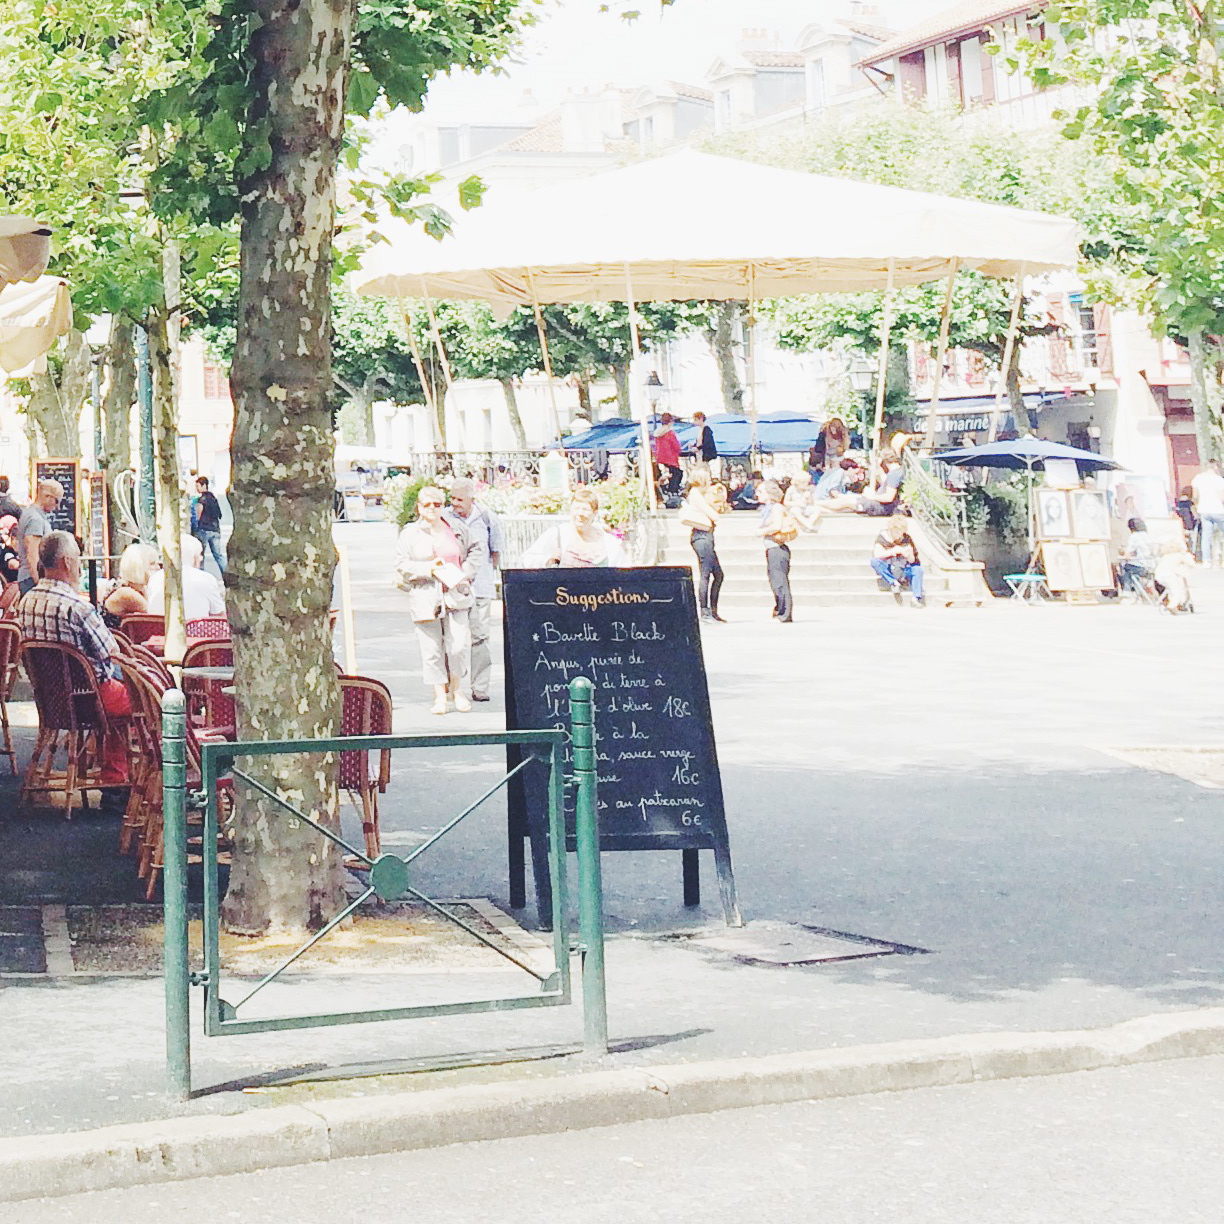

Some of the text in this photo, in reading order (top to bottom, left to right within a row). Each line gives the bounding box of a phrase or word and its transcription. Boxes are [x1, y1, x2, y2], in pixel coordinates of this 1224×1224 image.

[555, 586, 650, 612] Suggestions
[542, 621, 666, 644] Bavette Black
[534, 650, 583, 680] Angus,
[619, 672, 650, 689] terre
[654, 673, 667, 687] à
[607, 695, 653, 713] d'olive
[612, 727, 624, 739] à
[629, 721, 650, 739] la
[617, 750, 656, 761] sauce
[615, 799, 633, 808] au
[681, 810, 702, 826] 6€
